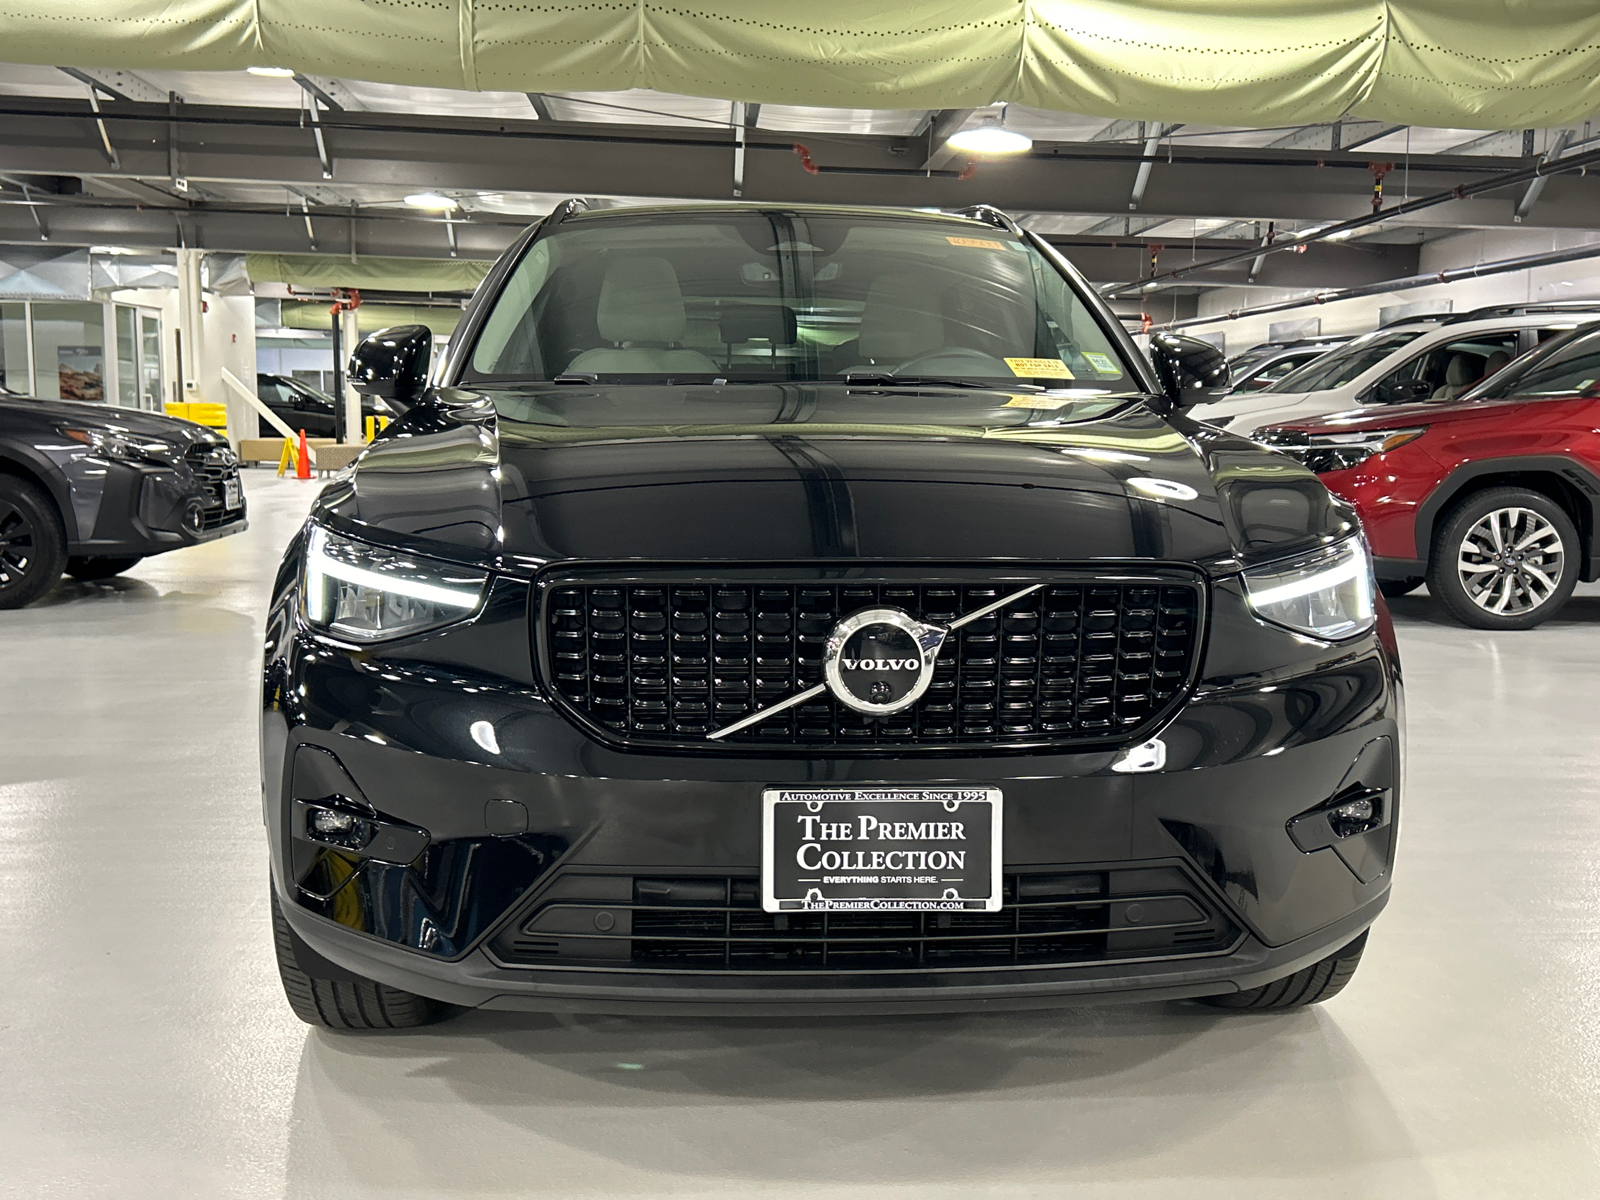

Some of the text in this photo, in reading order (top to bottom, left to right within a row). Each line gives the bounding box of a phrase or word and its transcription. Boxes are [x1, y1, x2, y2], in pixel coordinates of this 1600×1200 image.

[842, 658, 920, 671] VOLVO
[782, 791, 986, 801] AUTOMOTIVE EXCELLENCE SINCE 1995
[797, 815, 967, 841] THE PREMIER
[796, 843, 966, 871] COLLECTION
[823, 876, 938, 884] EVERYTHING STARTS HERE.
